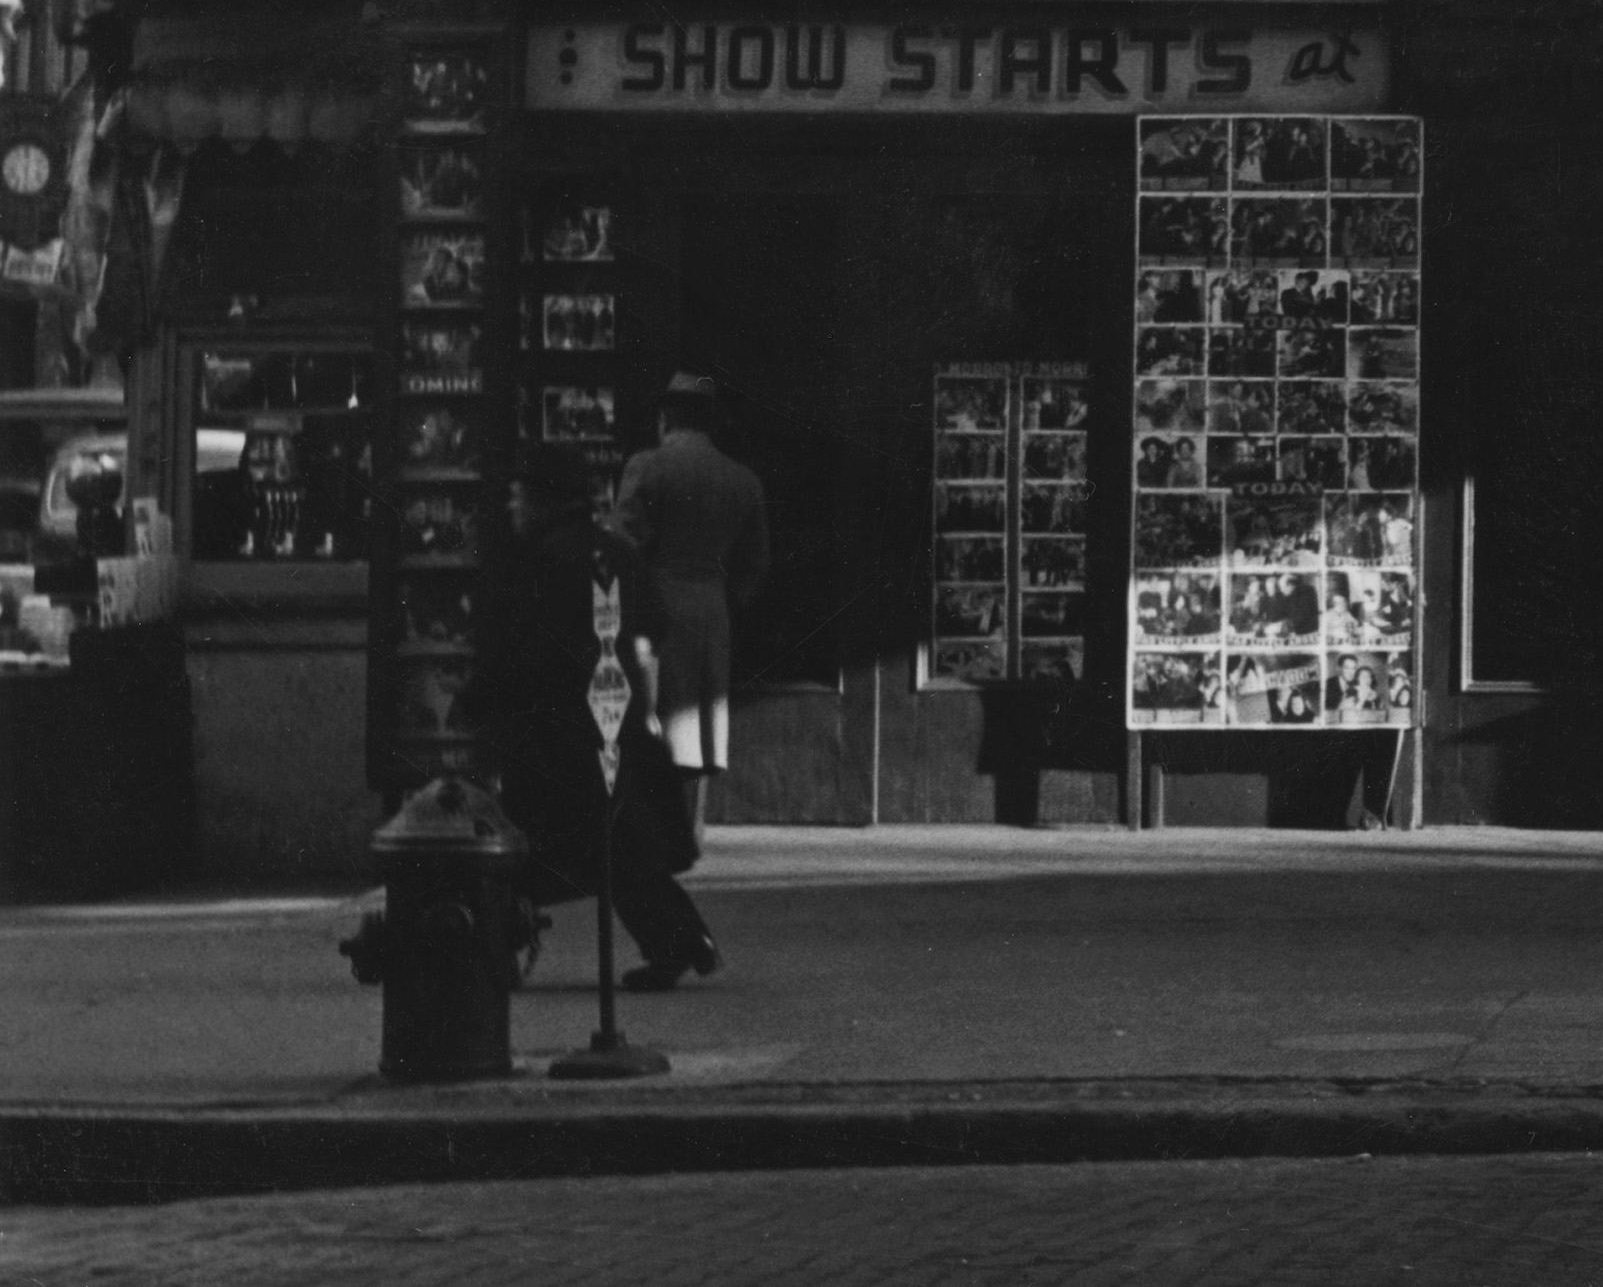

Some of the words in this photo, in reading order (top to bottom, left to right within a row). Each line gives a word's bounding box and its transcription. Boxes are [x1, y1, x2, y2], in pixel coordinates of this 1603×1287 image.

[621, 26, 845, 95] SHOW
[888, 27, 1253, 97] STARTS
[1288, 32, 1362, 85] at
[1244, 314, 1333, 331] TODAY
[1232, 481, 1323, 496] TODAY
